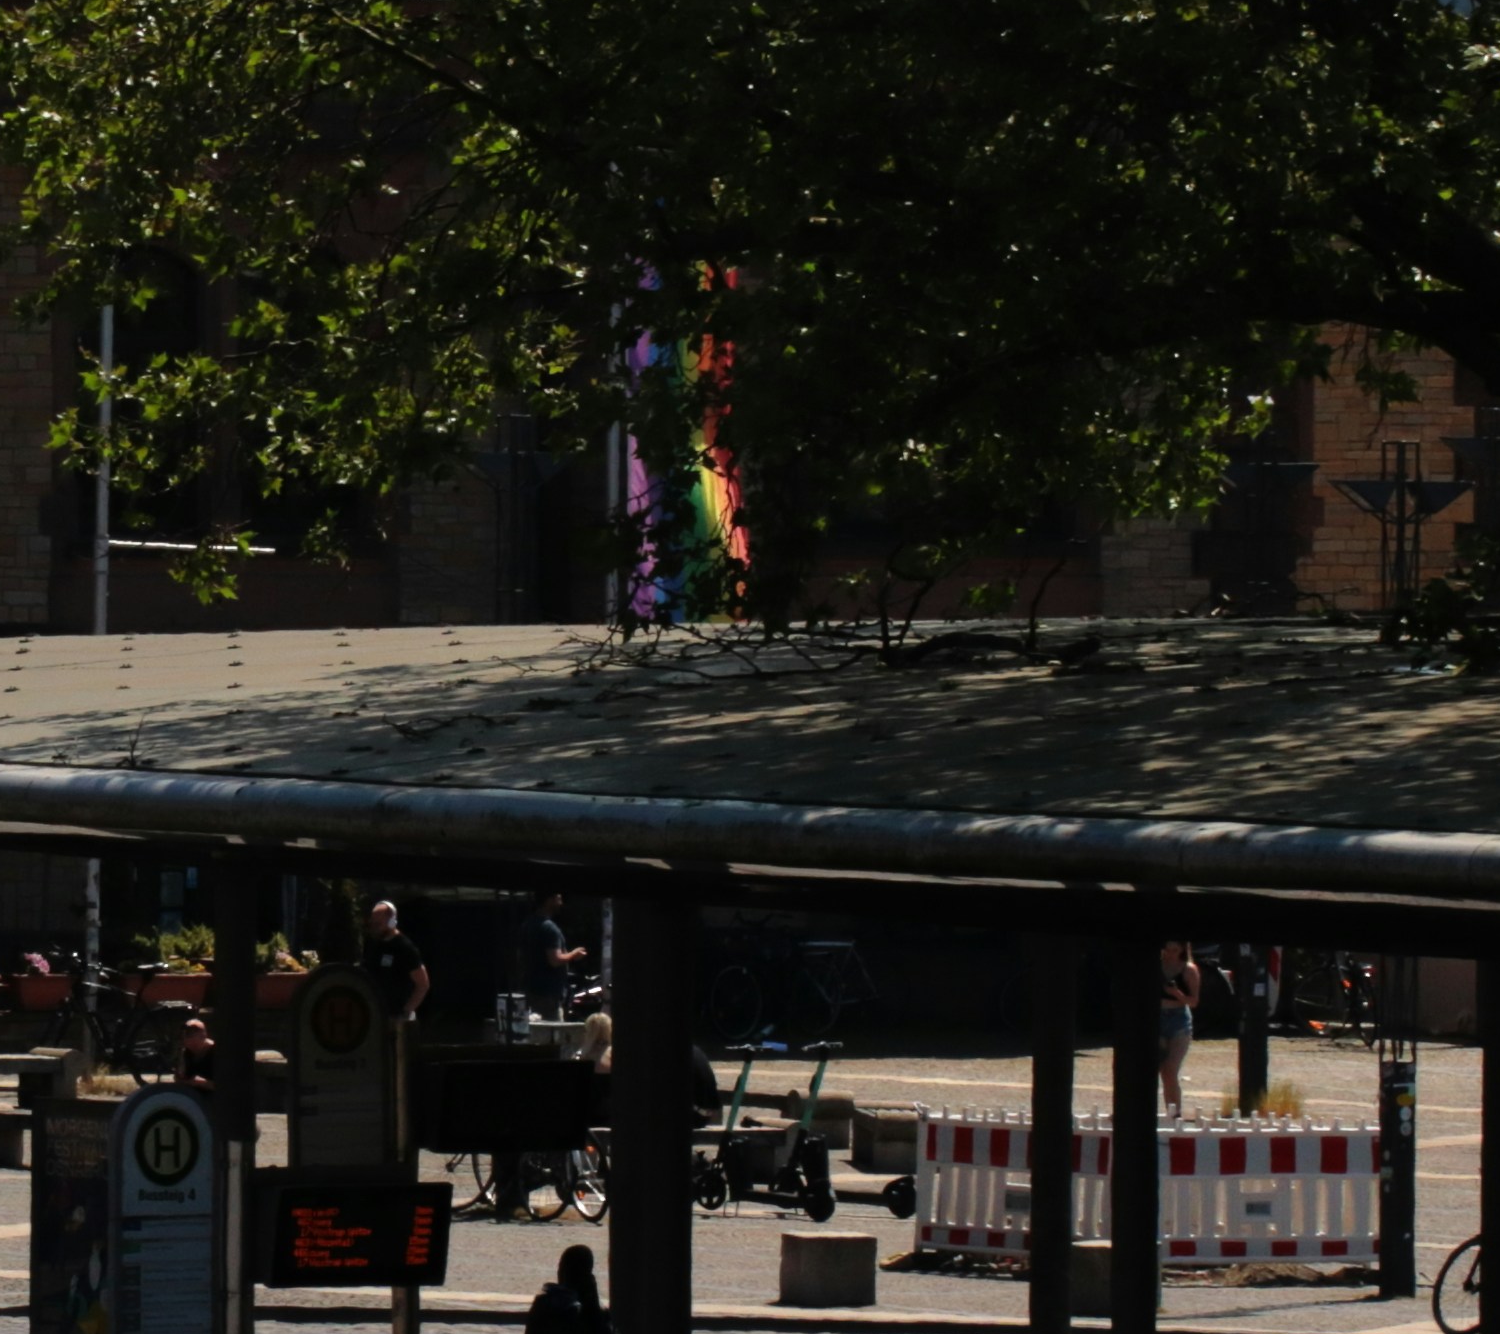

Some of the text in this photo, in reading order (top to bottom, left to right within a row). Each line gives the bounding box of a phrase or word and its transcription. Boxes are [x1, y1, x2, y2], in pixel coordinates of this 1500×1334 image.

[153, 1126, 180, 1169] H
[138, 1189, 196, 1204] Bussteig 4
